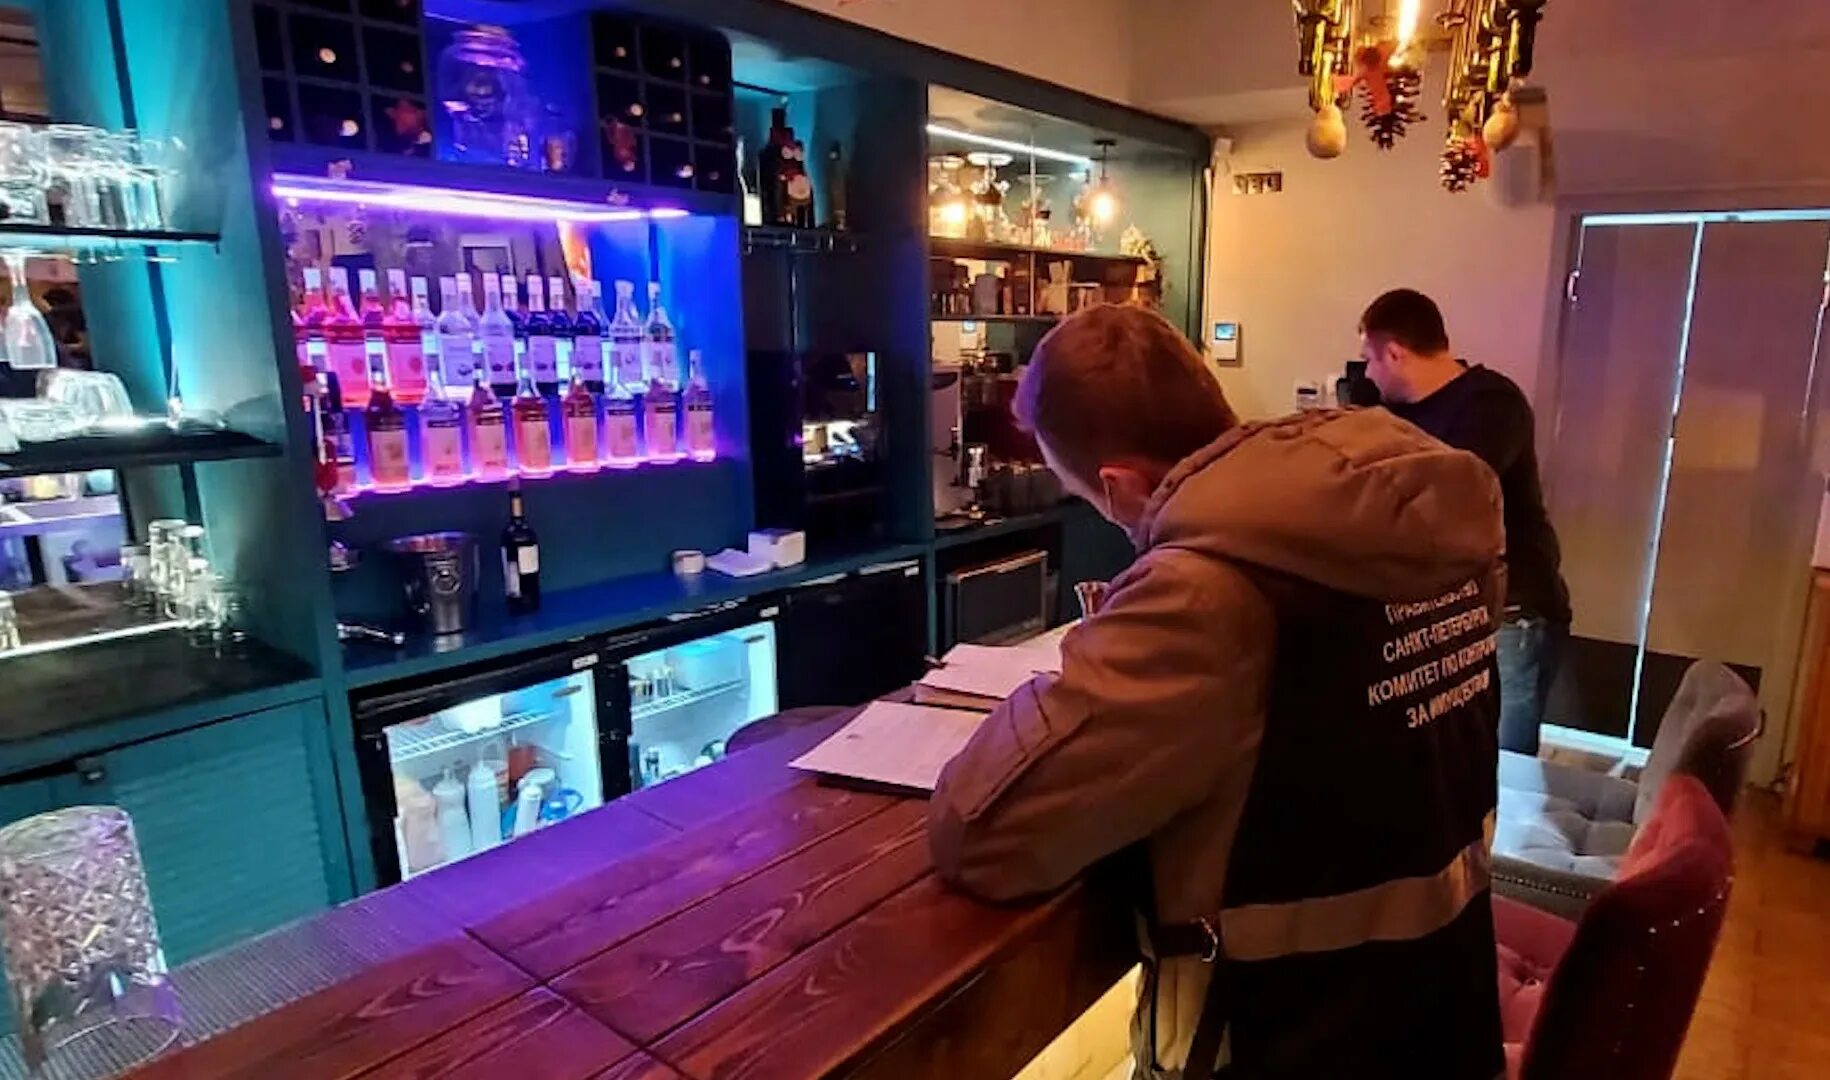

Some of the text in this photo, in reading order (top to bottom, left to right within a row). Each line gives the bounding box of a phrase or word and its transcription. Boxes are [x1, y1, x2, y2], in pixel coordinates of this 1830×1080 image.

[1367, 661, 1440, 706] КОМИТЕТ
[1441, 654, 1458, 679] ПО
[1405, 703, 1430, 728] ЗА
